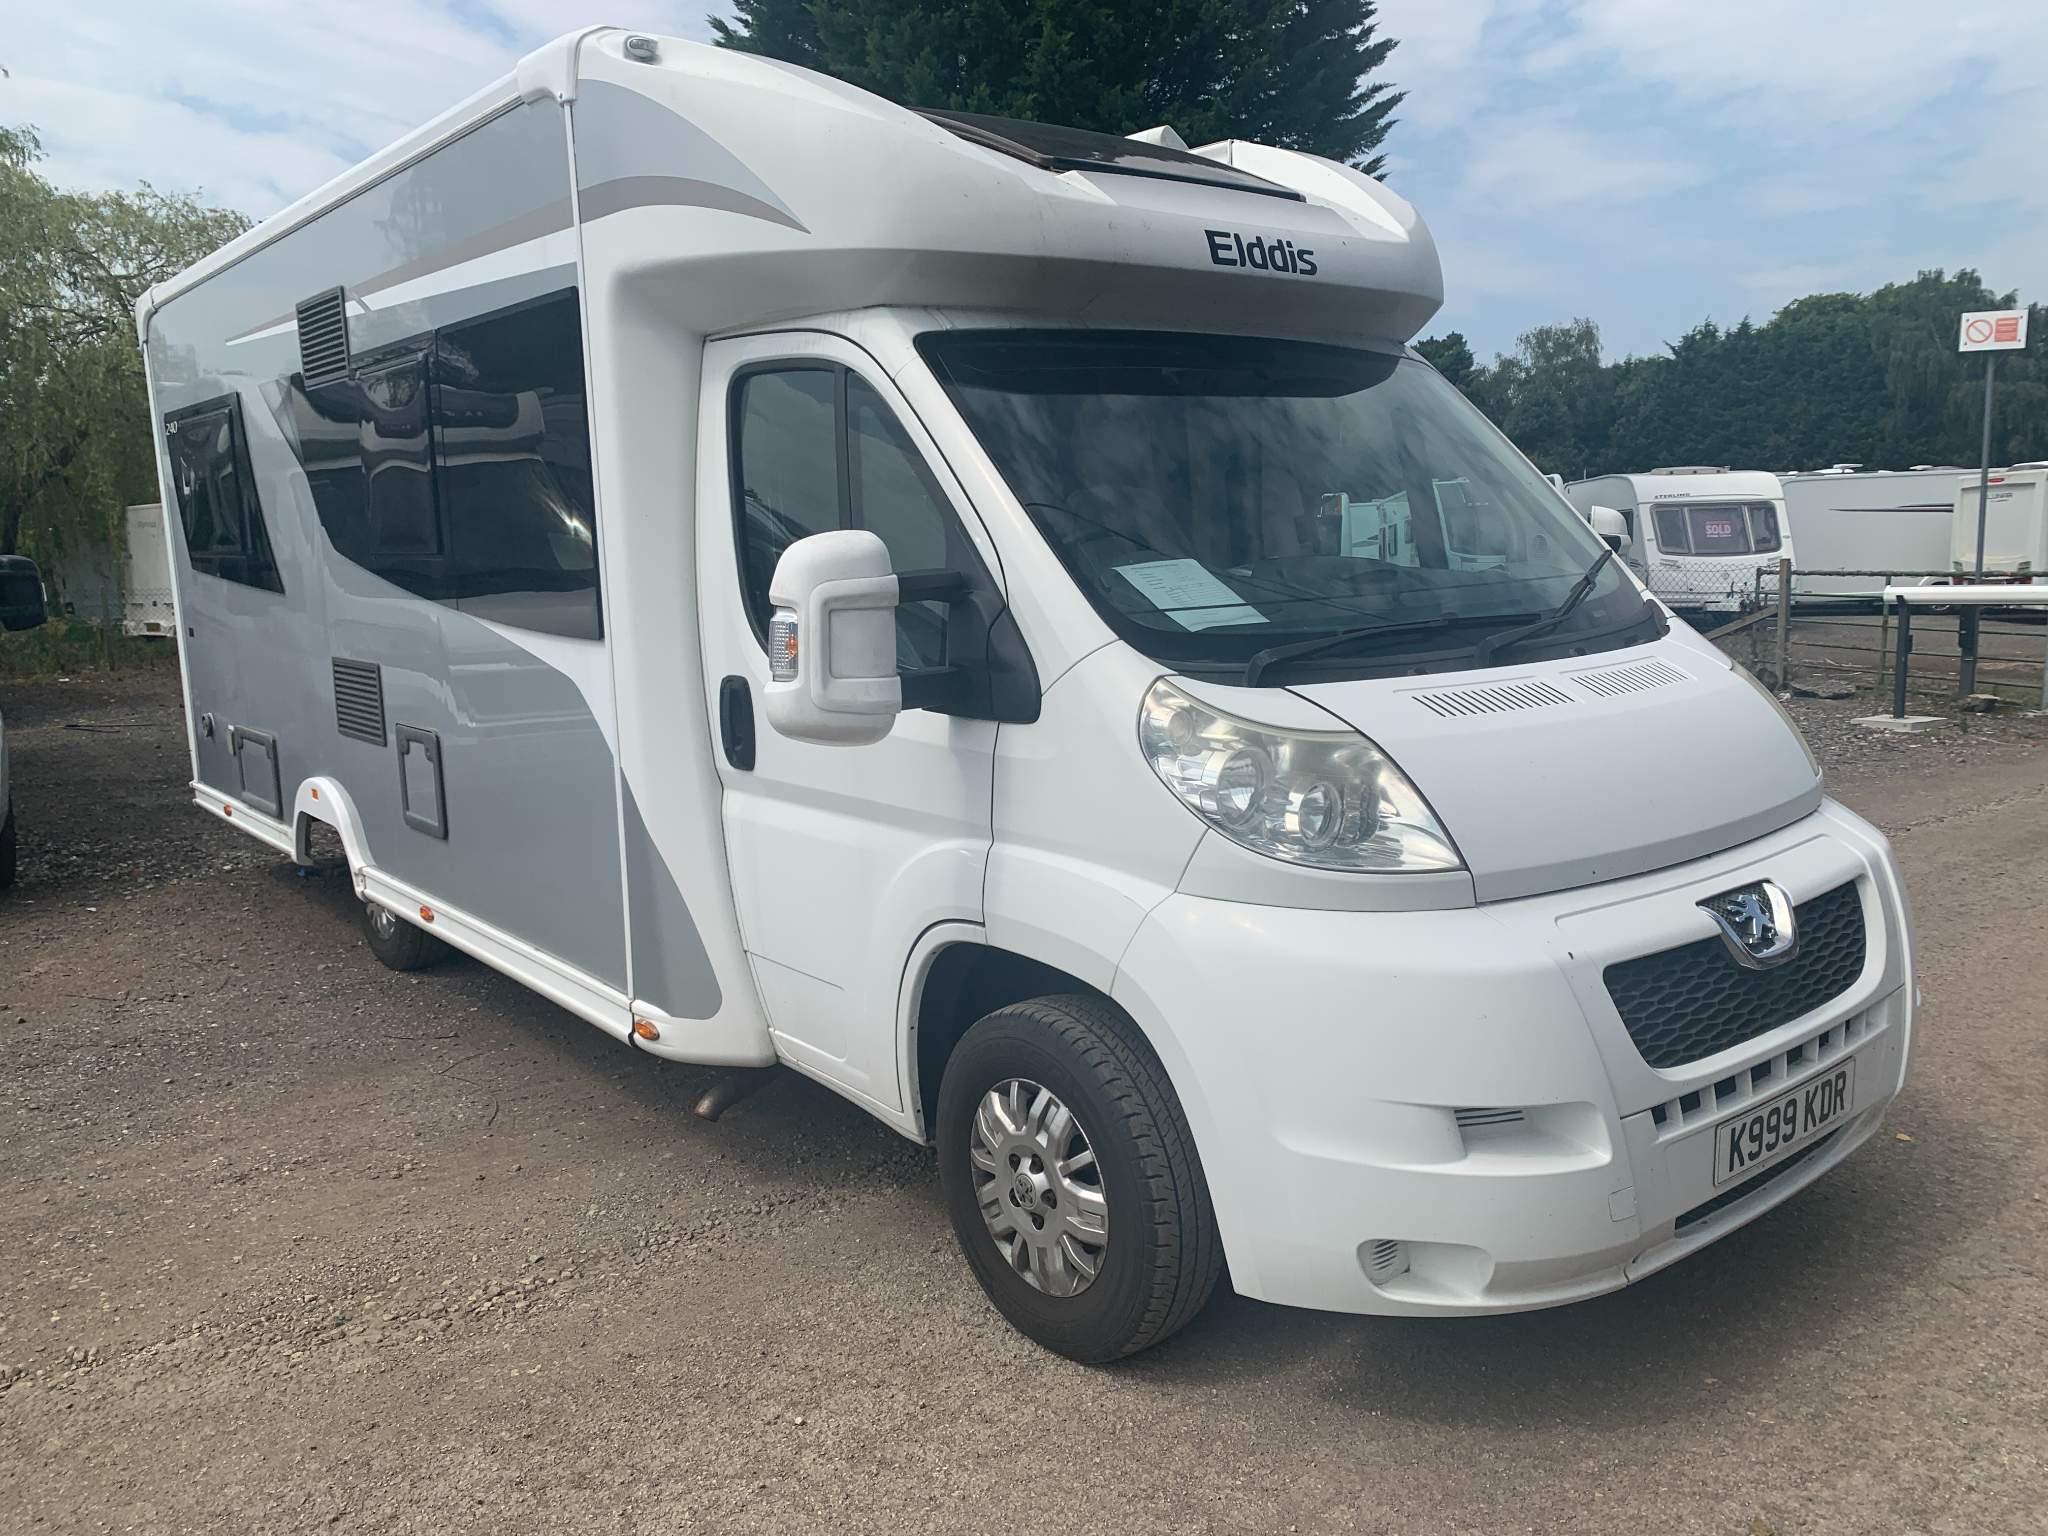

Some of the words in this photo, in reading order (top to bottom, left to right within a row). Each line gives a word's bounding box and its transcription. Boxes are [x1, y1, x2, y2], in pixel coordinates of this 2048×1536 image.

[1204, 229, 1317, 275] Elddis
[1704, 524, 1731, 535] SOLD
[1728, 1098, 1798, 1173] K999
[1803, 1070, 1847, 1133] KDR
